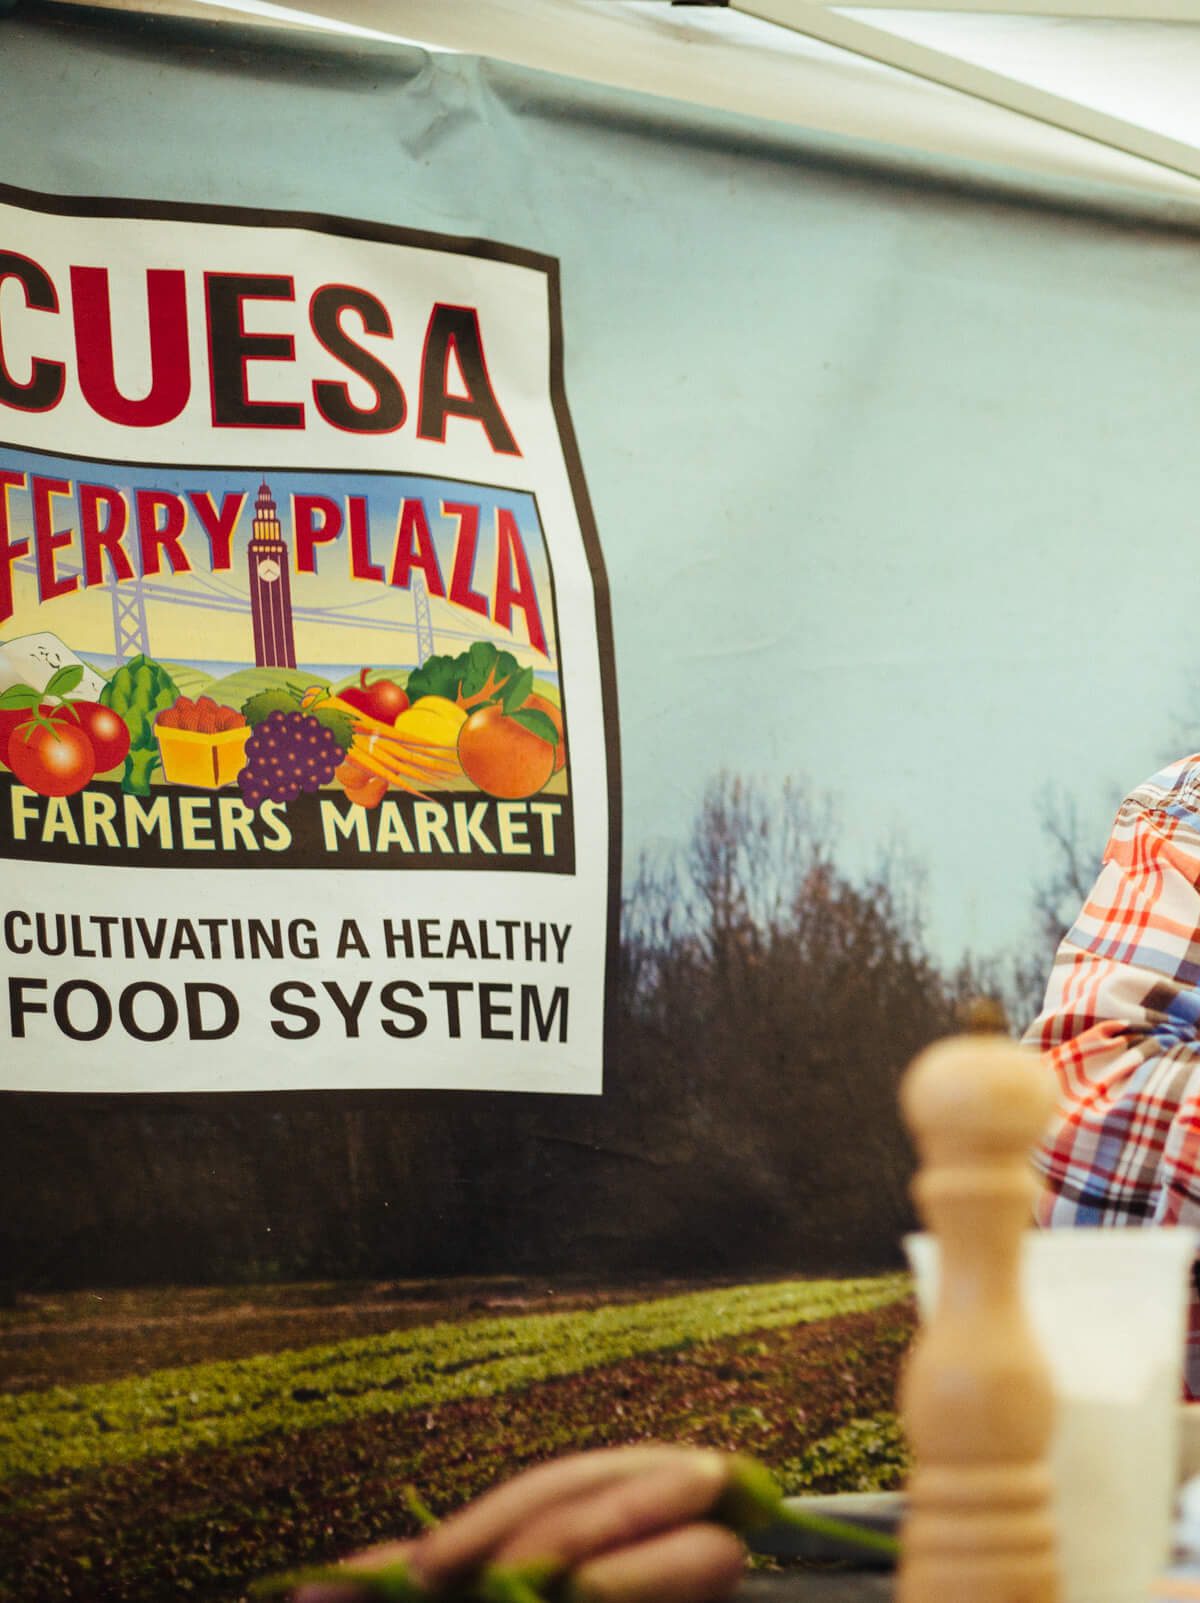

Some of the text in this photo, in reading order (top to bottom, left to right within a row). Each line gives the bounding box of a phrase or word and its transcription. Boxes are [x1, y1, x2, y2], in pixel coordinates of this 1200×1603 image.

[0, 250, 523, 457] CUESA
[0, 470, 549, 655] FERRY PLAZA
[11, 784, 562, 857] FARMERS MARKET
[4, 910, 573, 964] CULTIVATING A HEALTHY
[7, 976, 570, 1043] FOOD SYSTEM
